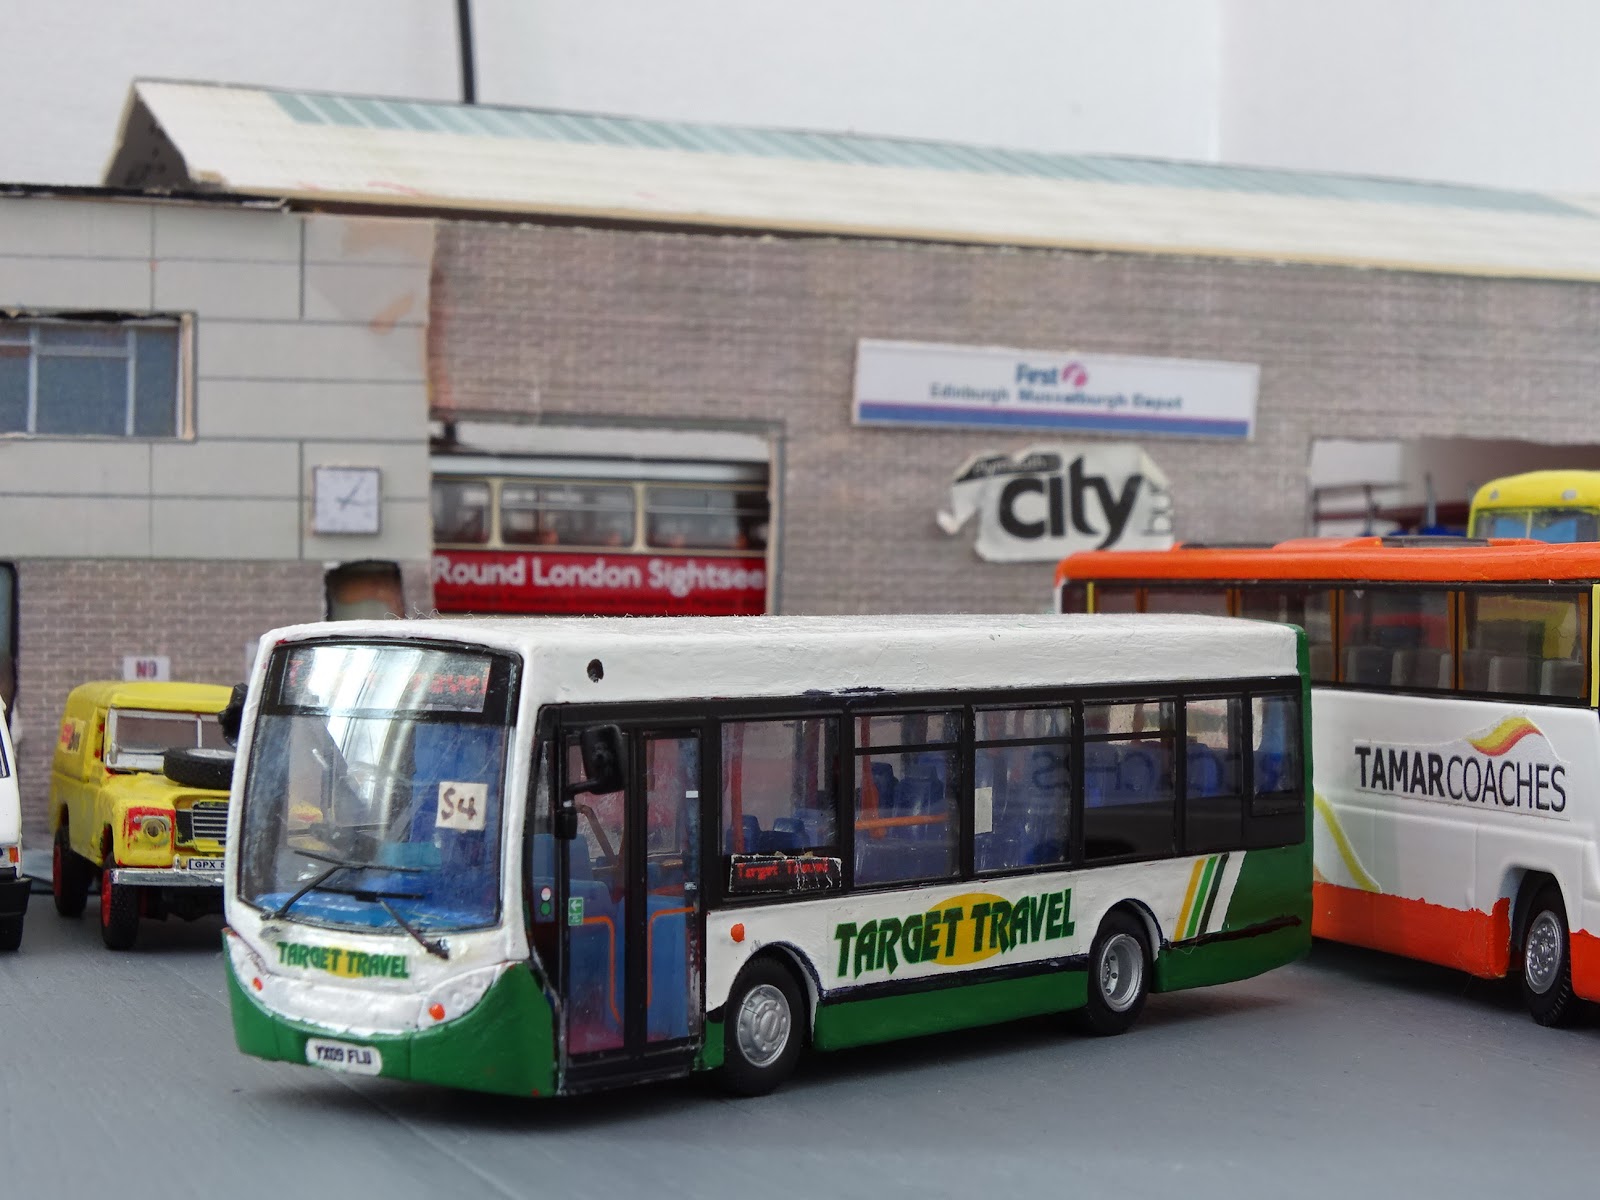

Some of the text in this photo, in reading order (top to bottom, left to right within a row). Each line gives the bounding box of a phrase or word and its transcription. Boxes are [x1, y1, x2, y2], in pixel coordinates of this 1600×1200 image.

[1015, 363, 1058, 385] First
[930, 382, 1183, 411] Edinburgh Musselburgh Depot
[1000, 455, 1144, 550] city
[432, 555, 526, 587] Round
[532, 557, 641, 588] London
[441, 787, 477, 820] S4
[195, 861, 215, 869] GPX
[737, 861, 779, 880] Target
[834, 888, 1075, 979] TARGET TRAVEL
[276, 942, 409, 978] TARGET TRAVEL
